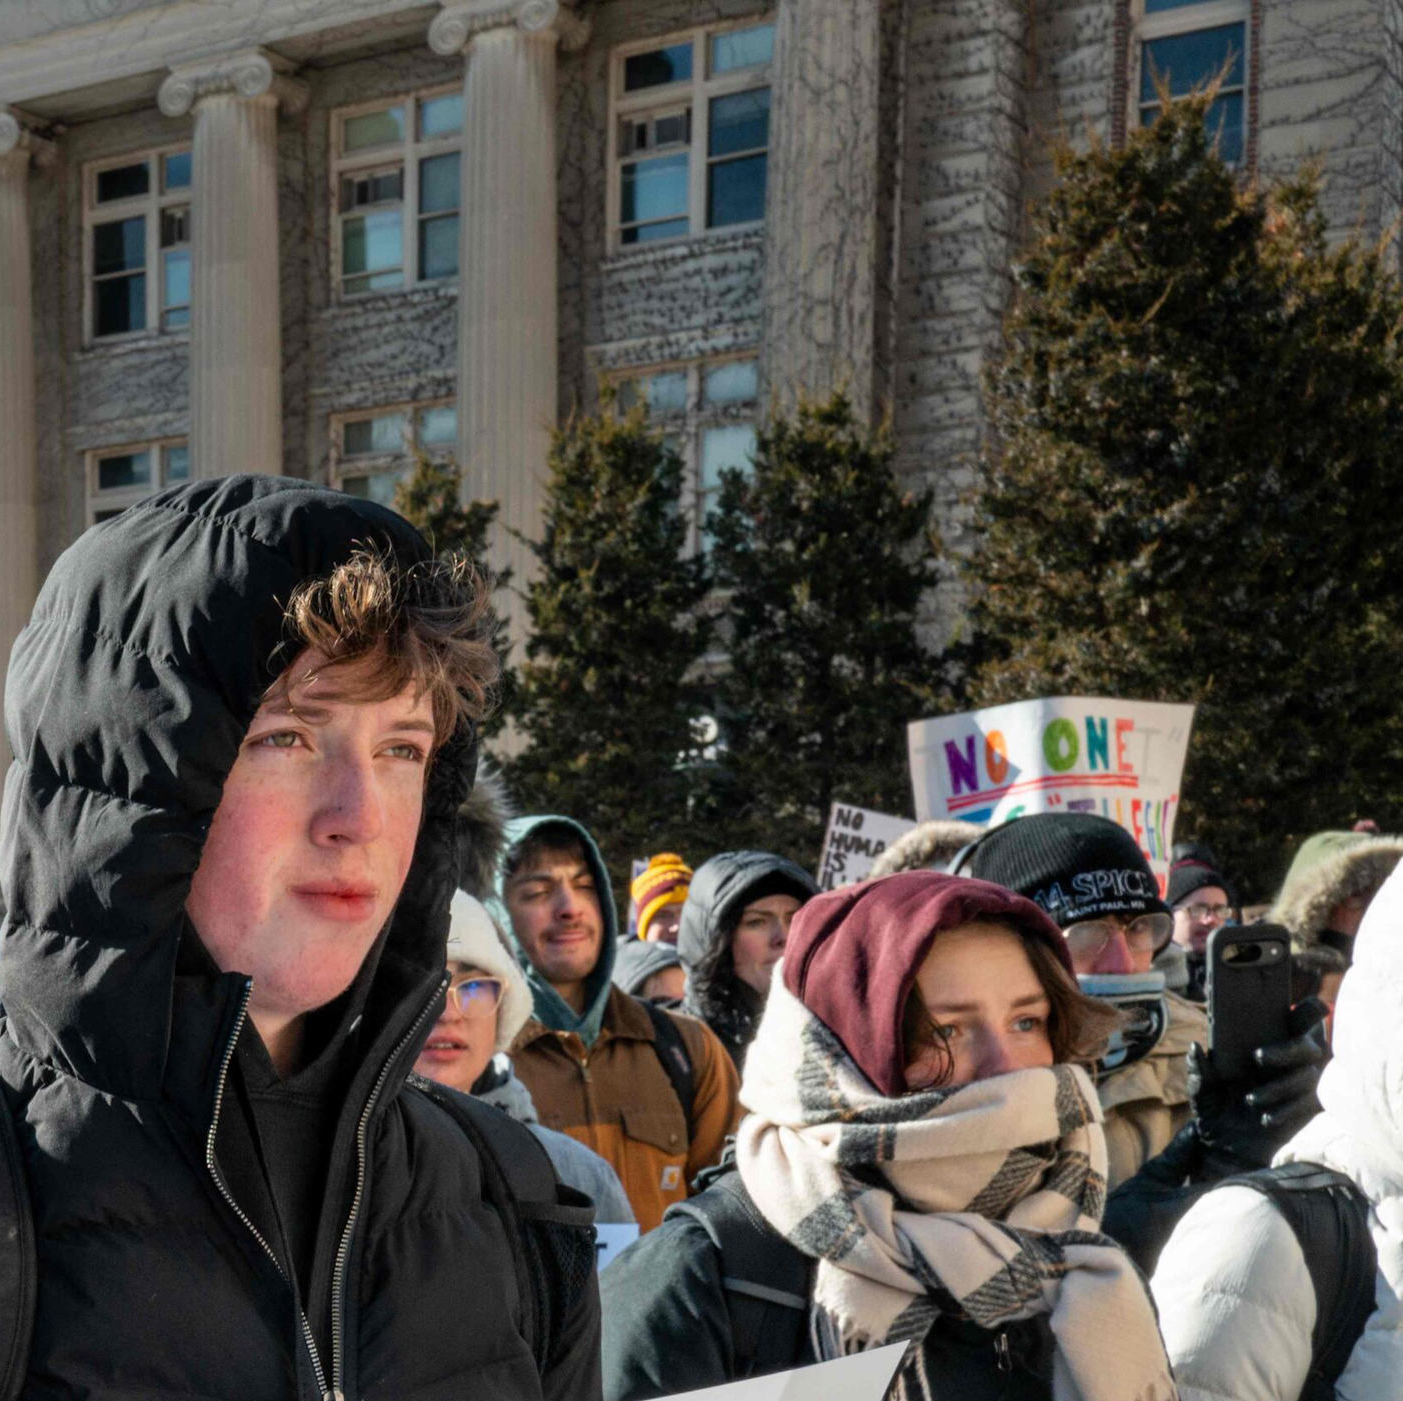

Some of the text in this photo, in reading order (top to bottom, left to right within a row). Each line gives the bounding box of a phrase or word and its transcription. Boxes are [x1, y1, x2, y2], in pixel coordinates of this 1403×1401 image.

[944, 716, 1134, 795] NO ONE
[835, 808, 864, 831] NO
[824, 851, 847, 872] IS
